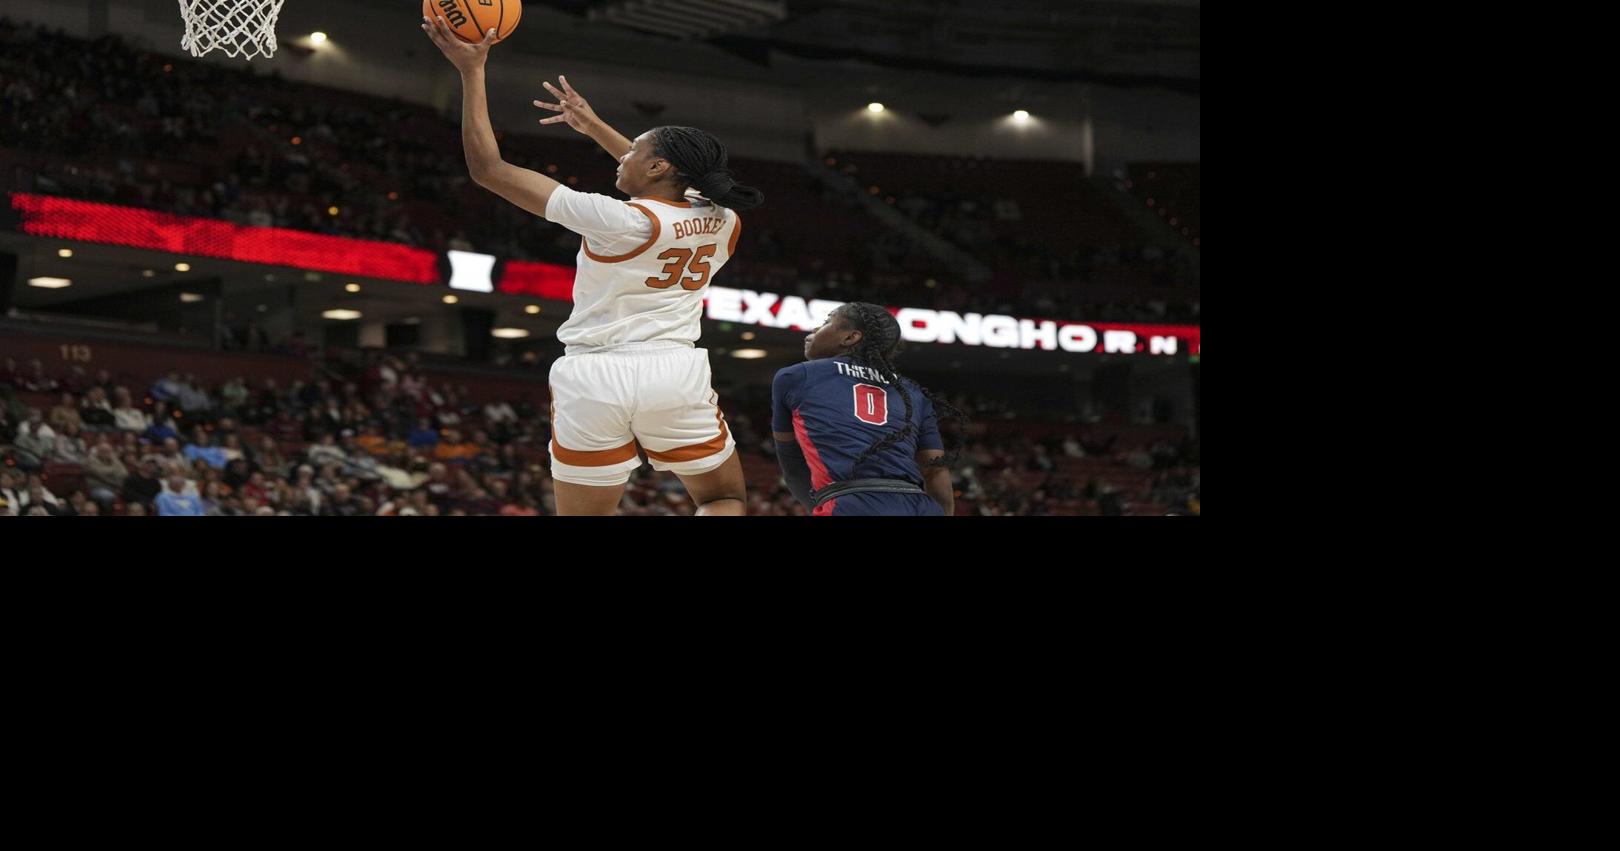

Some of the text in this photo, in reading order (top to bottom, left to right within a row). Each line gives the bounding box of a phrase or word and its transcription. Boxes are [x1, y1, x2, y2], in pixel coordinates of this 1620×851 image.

[439, 0, 467, 29] Wil
[672, 217, 726, 240] BOOKE
[645, 244, 717, 292] 35
[898, 307, 1177, 355] ONGHORN
[853, 383, 888, 426] 0
